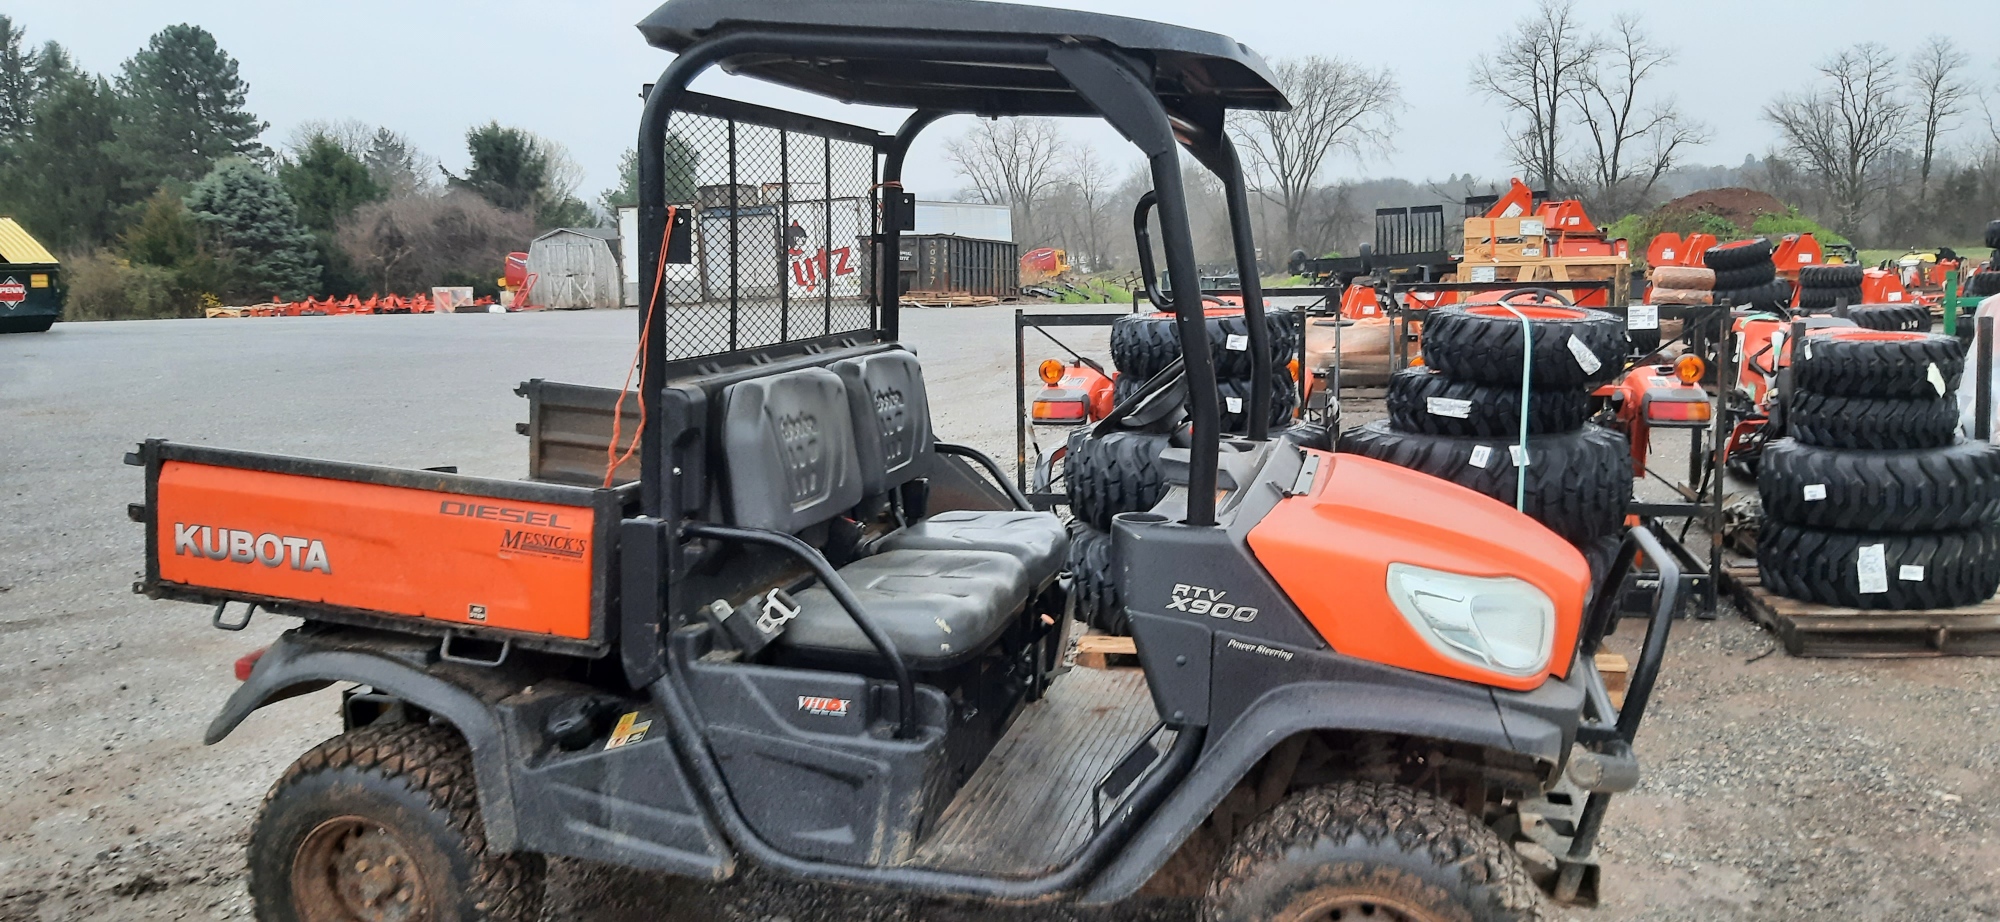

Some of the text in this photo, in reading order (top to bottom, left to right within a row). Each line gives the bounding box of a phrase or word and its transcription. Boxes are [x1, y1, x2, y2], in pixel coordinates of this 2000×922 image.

[440, 501, 571, 530] DIESEL
[174, 522, 332, 575] KUBOTA
[500, 529, 587, 551] MESSICK'S
[1172, 583, 1227, 602] RTV
[1165, 595, 1259, 623] X900
[1227, 638, 1294, 662] Power Steering
